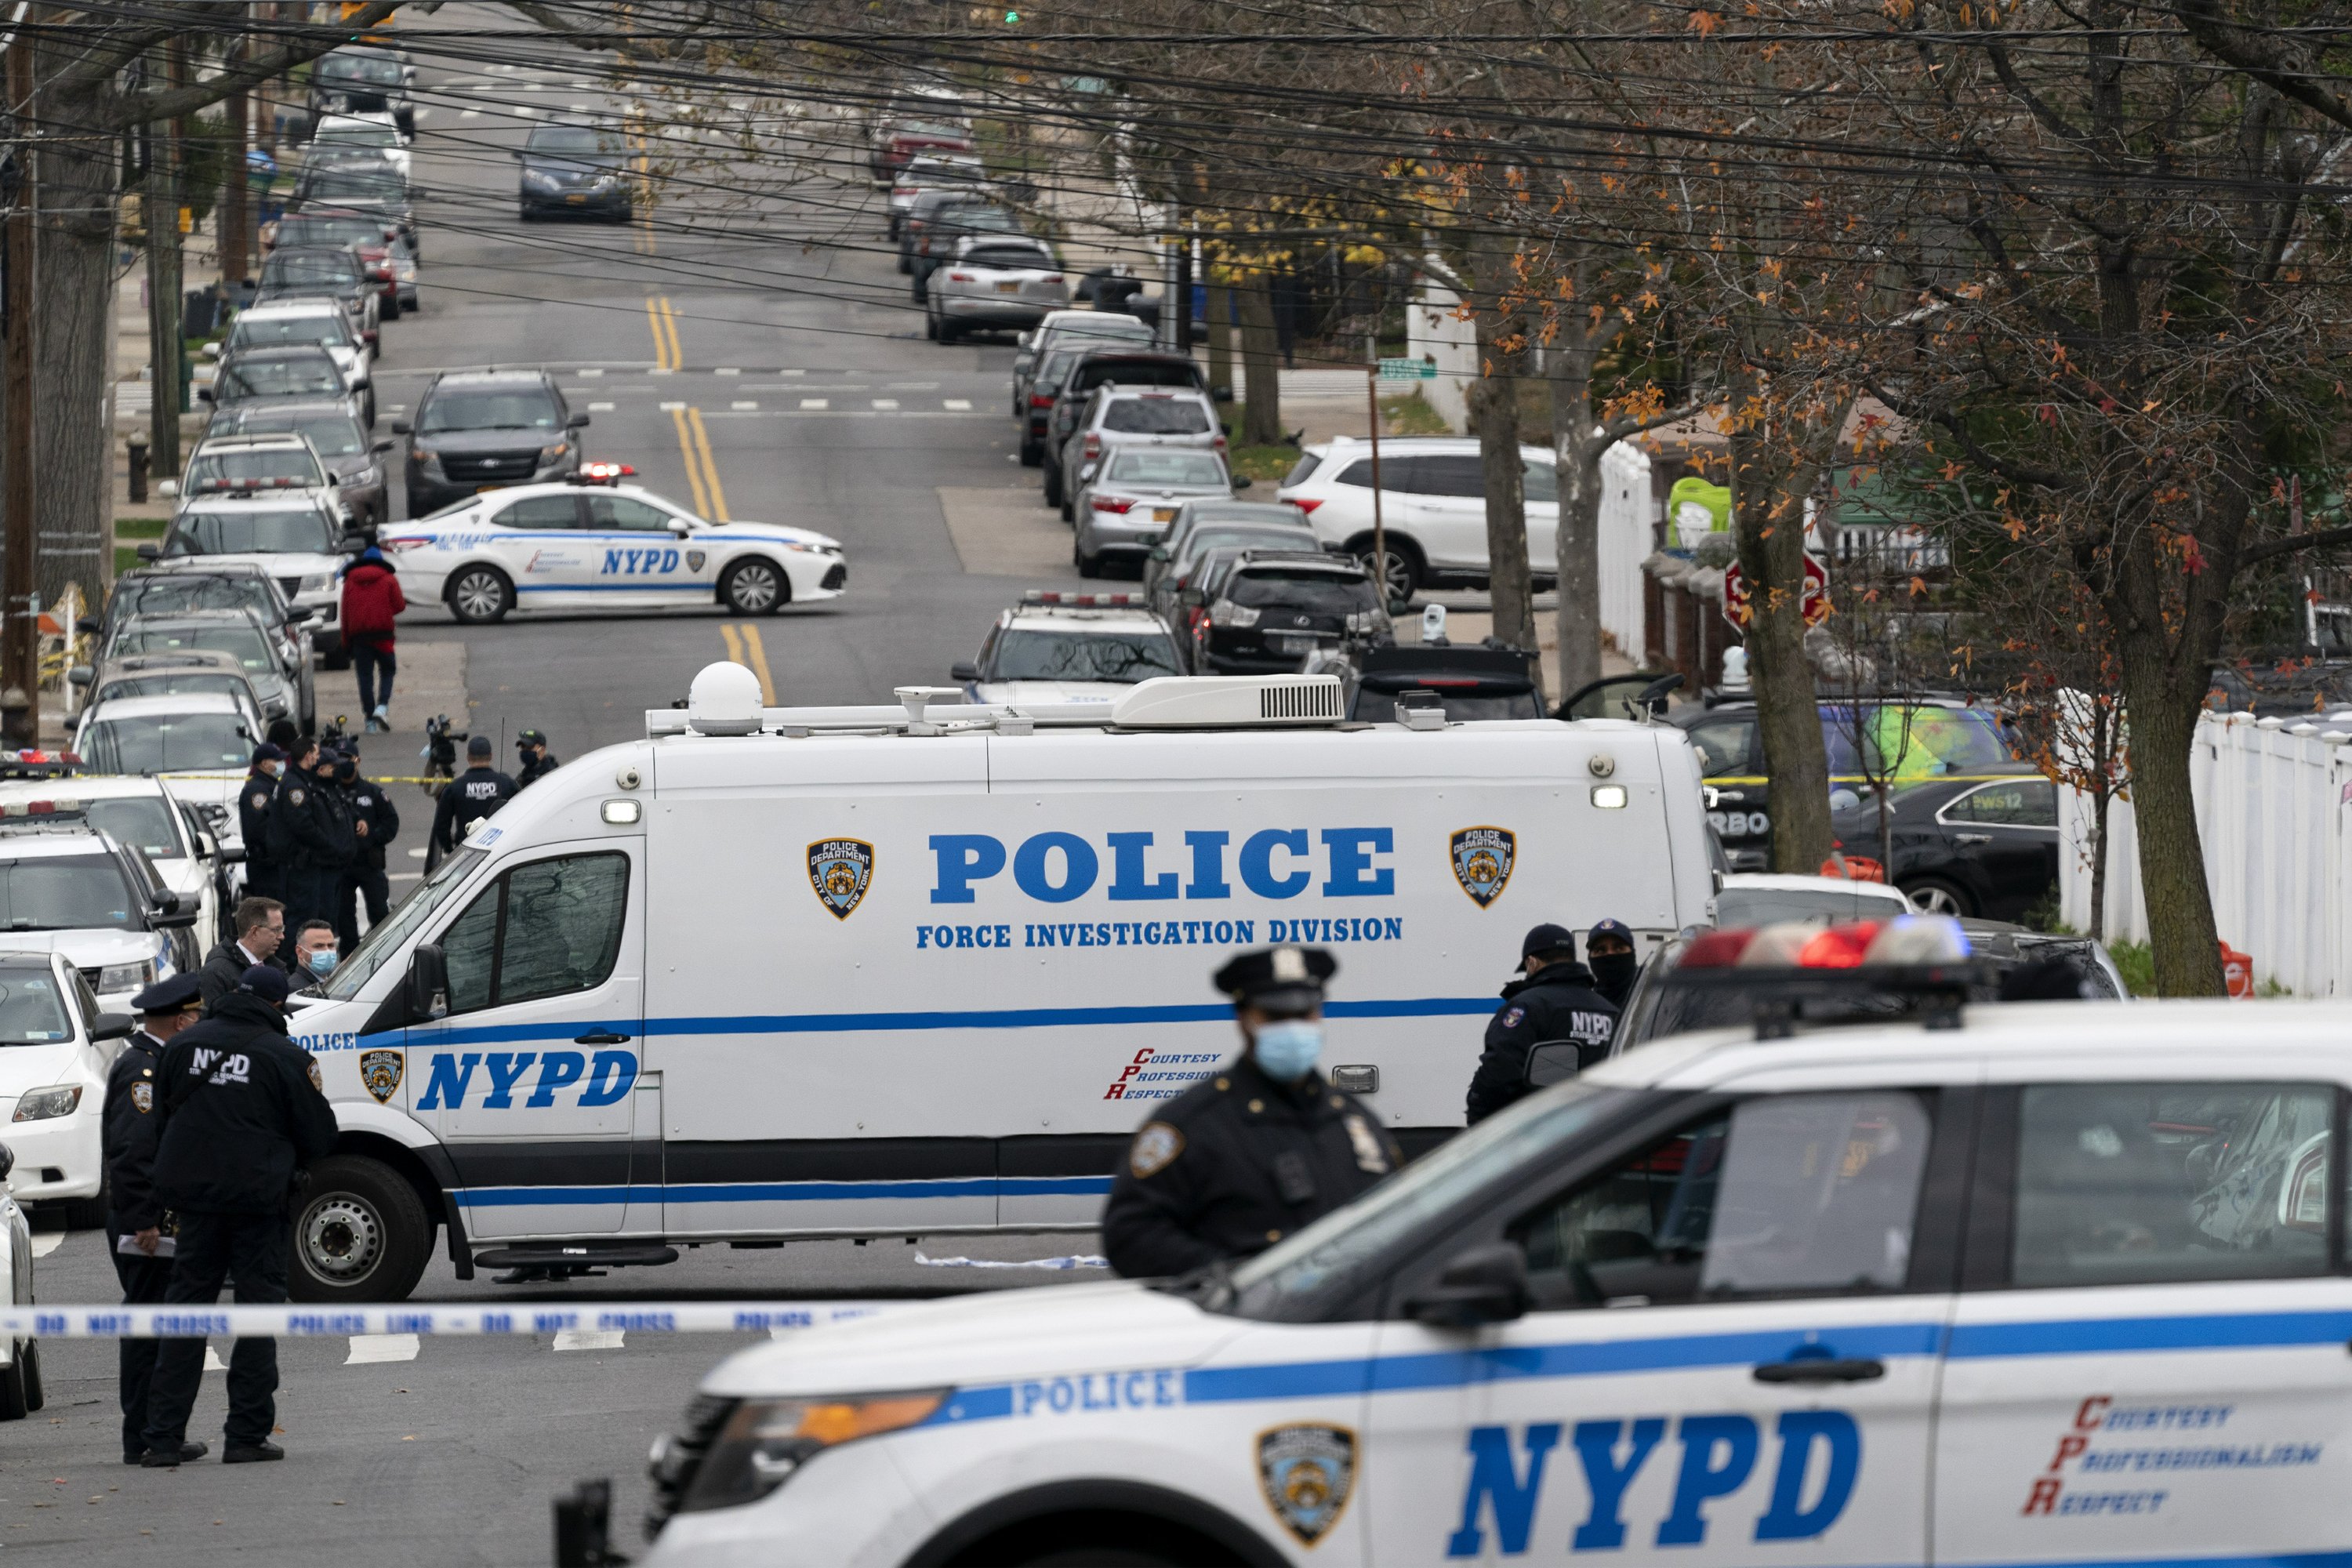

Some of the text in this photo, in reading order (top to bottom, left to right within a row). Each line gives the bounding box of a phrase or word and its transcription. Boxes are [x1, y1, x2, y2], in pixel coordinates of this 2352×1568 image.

[601, 549, 679, 574] NYPD
[466, 782, 496, 794] NYPD
[822, 842, 858, 852] POLICE
[1454, 838, 1512, 855] DEPARTMENT
[1465, 829, 1501, 840] POLICE
[811, 851, 870, 866] DEPARTMENT
[929, 827, 1395, 904] POLICE
[812, 874, 834, 906] CITY OF
[846, 869, 870, 910] NEW YORK
[1455, 862, 1478, 895] CITY OF
[1489, 857, 1512, 898] NEW YORK
[916, 917, 1403, 949] FORCE INVESTIGATION DIVISION
[1571, 1011, 1613, 1036] NYPD
[193, 1047, 251, 1076] NYPD
[362, 1058, 401, 1068] DEPARTMENT
[1133, 1048, 1221, 1064] COURTESY
[220, 1072, 250, 1083] RESPONSE
[416, 1051, 638, 1111] NYPD
[1103, 1083, 1185, 1099] RESPECT
[34, 1314, 67, 1335] DO
[86, 1314, 132, 1335] NOT
[1022, 1370, 1174, 1414] POLICE
[1445, 1409, 1864, 1559] NYPD
